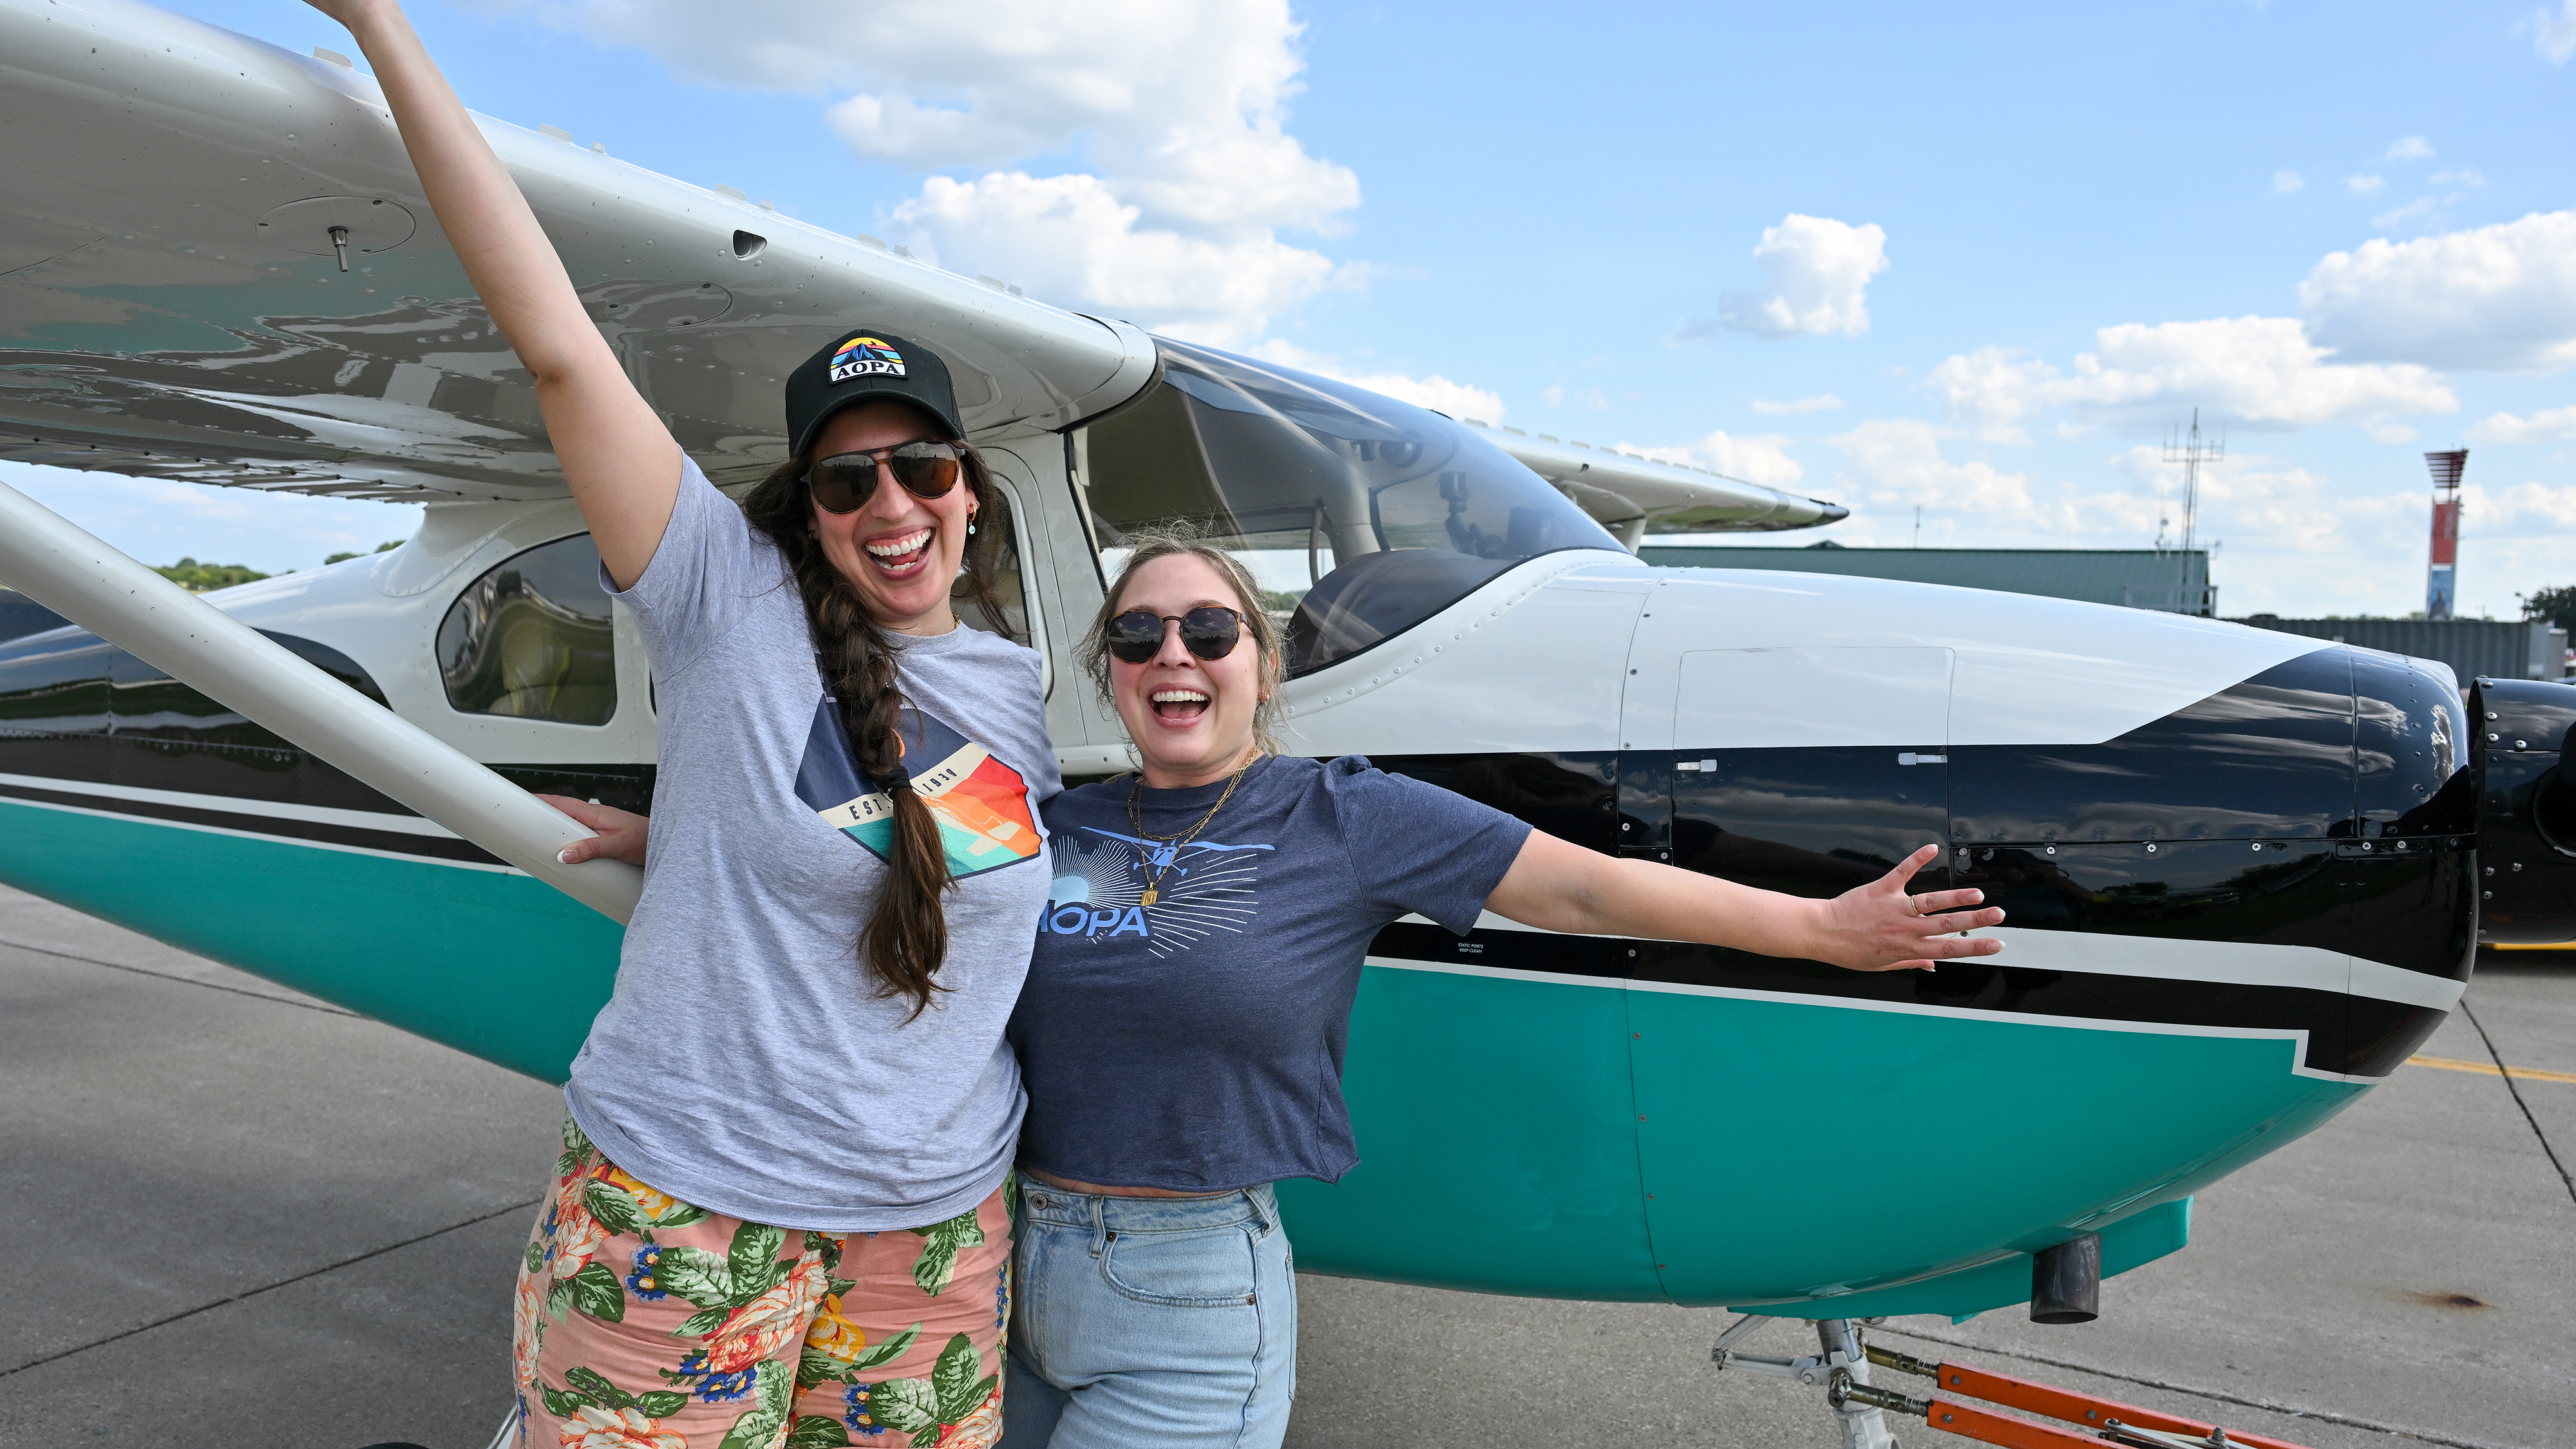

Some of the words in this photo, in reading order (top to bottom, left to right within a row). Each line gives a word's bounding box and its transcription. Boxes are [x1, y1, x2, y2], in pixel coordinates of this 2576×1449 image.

[837, 362, 900, 379] AOPA
[849, 799, 891, 820] EST.
[922, 768, 958, 792] 1939
